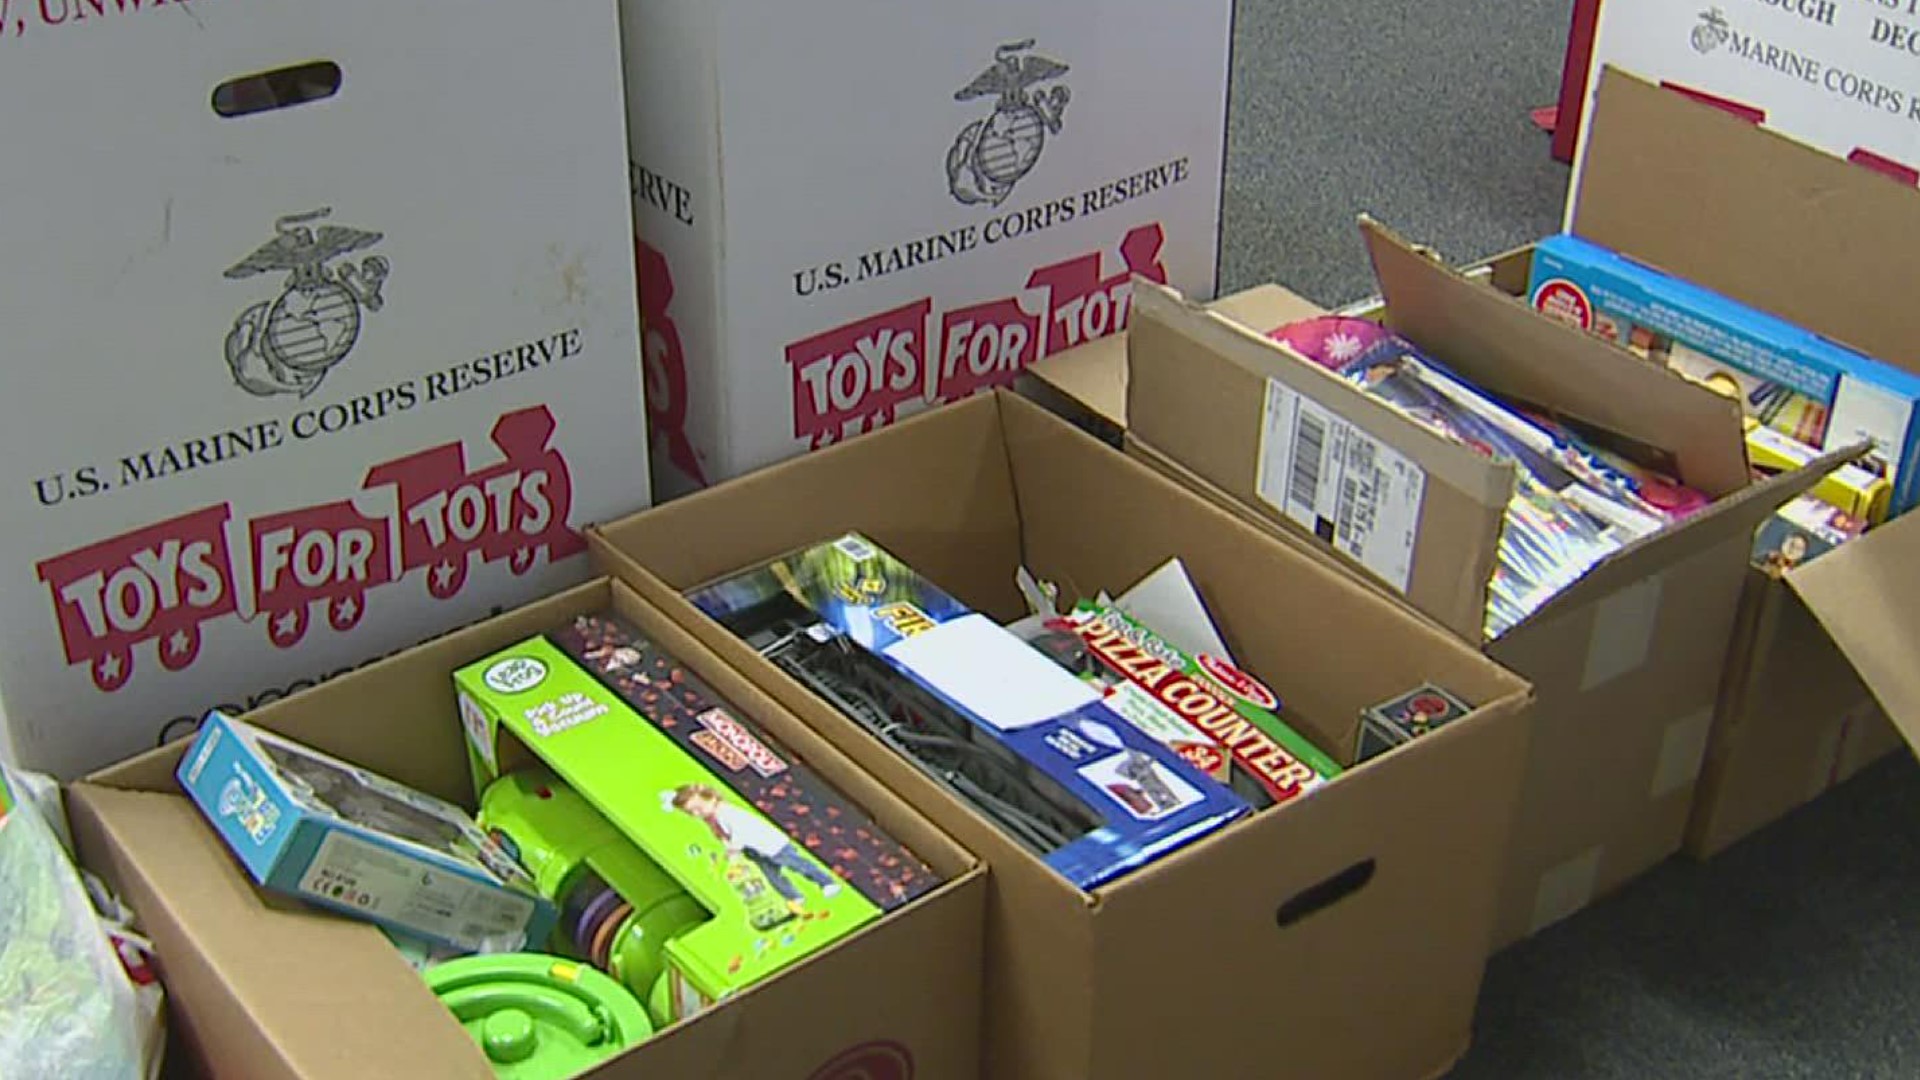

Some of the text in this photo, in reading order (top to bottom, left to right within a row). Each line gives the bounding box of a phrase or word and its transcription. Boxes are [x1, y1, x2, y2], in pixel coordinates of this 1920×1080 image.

[1729, 31, 1820, 84] MARINE
[1824, 68, 1903, 114] CORPS
[794, 157, 1189, 296] U.S. MARINE CORPS RESERVE
[34, 327, 584, 507] U.S. MARINE CORPS RESERVE
[800, 283, 1134, 415] TOYS FOR TOT
[60, 469, 552, 638] TOYS FOR TOTS
[1074, 615, 1172, 689] PIZZA
[1161, 679, 1311, 792] COUNTER
